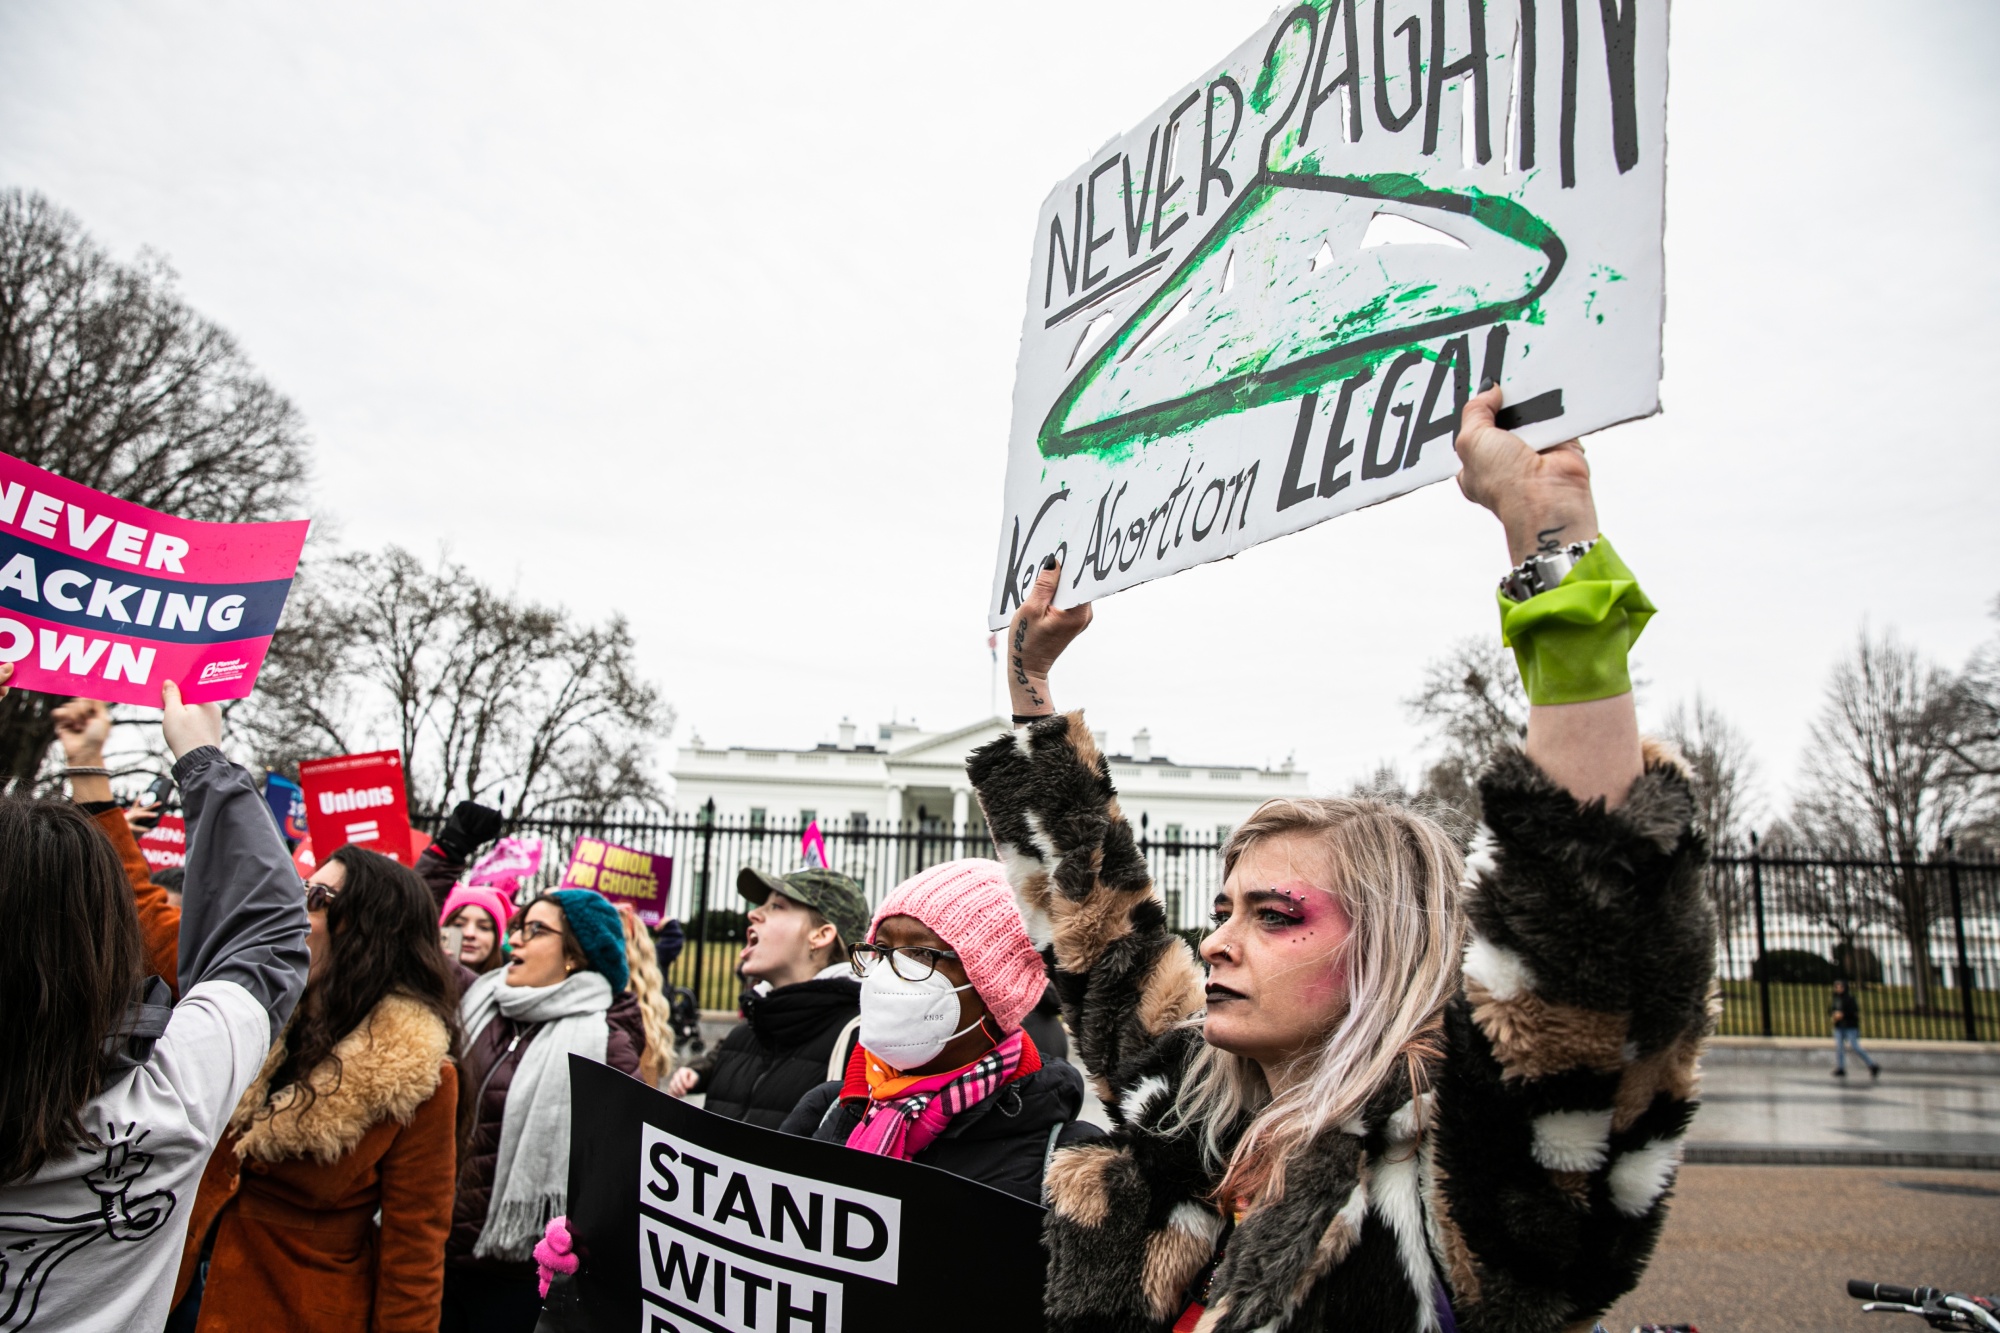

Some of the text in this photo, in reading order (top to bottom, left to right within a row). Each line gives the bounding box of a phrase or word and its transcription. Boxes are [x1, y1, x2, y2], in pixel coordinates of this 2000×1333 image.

[1044, 0, 1639, 310] NEVER AGAIN
[1073, 457, 1260, 589] Abortion
[1276, 322, 1565, 513] LEGAL
[318, 785, 395, 815] Unions
[597, 869, 659, 900] CHOICE
[646, 1141, 889, 1263] STAND
[646, 1228, 828, 1333] WITH
